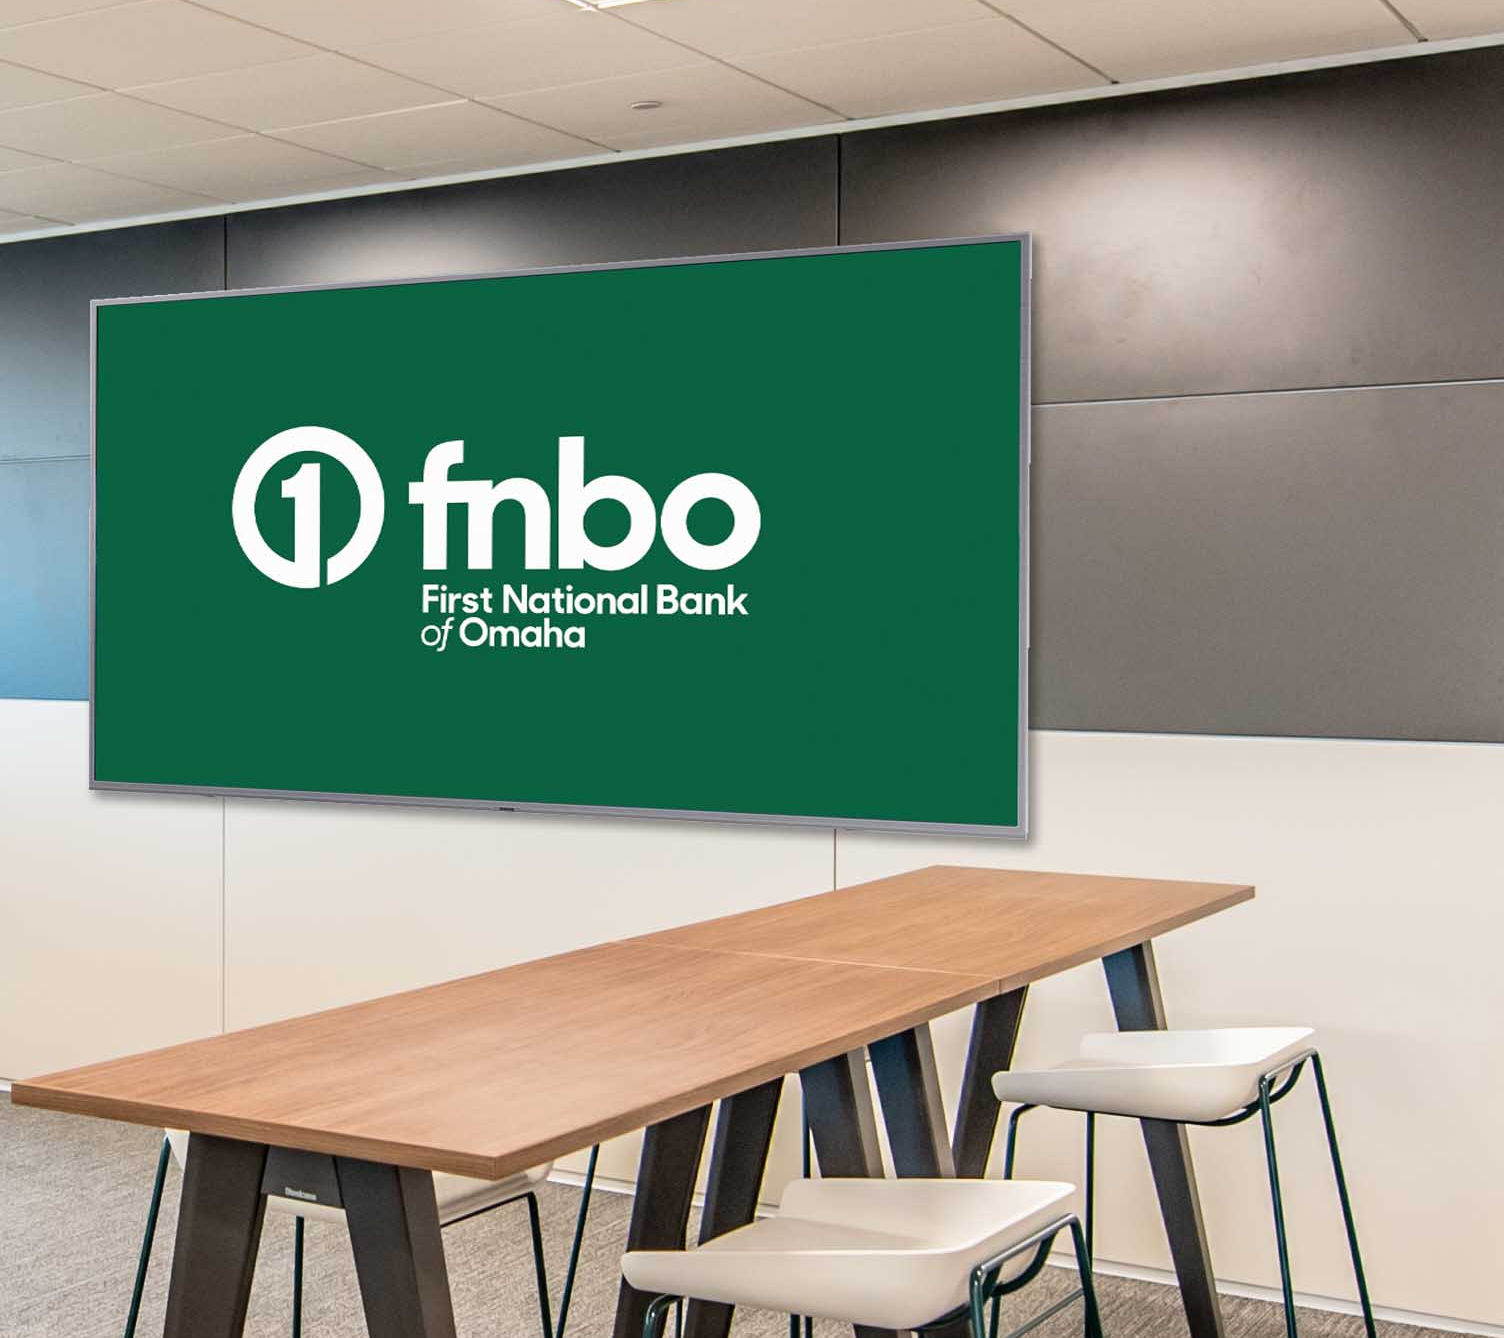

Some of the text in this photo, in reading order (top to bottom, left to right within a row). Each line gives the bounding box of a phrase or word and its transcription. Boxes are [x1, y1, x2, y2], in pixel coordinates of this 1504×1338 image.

[408, 435, 762, 571] fnbo
[422, 583, 749, 615] First National Bank
[420, 616, 586, 652] of Omaha
